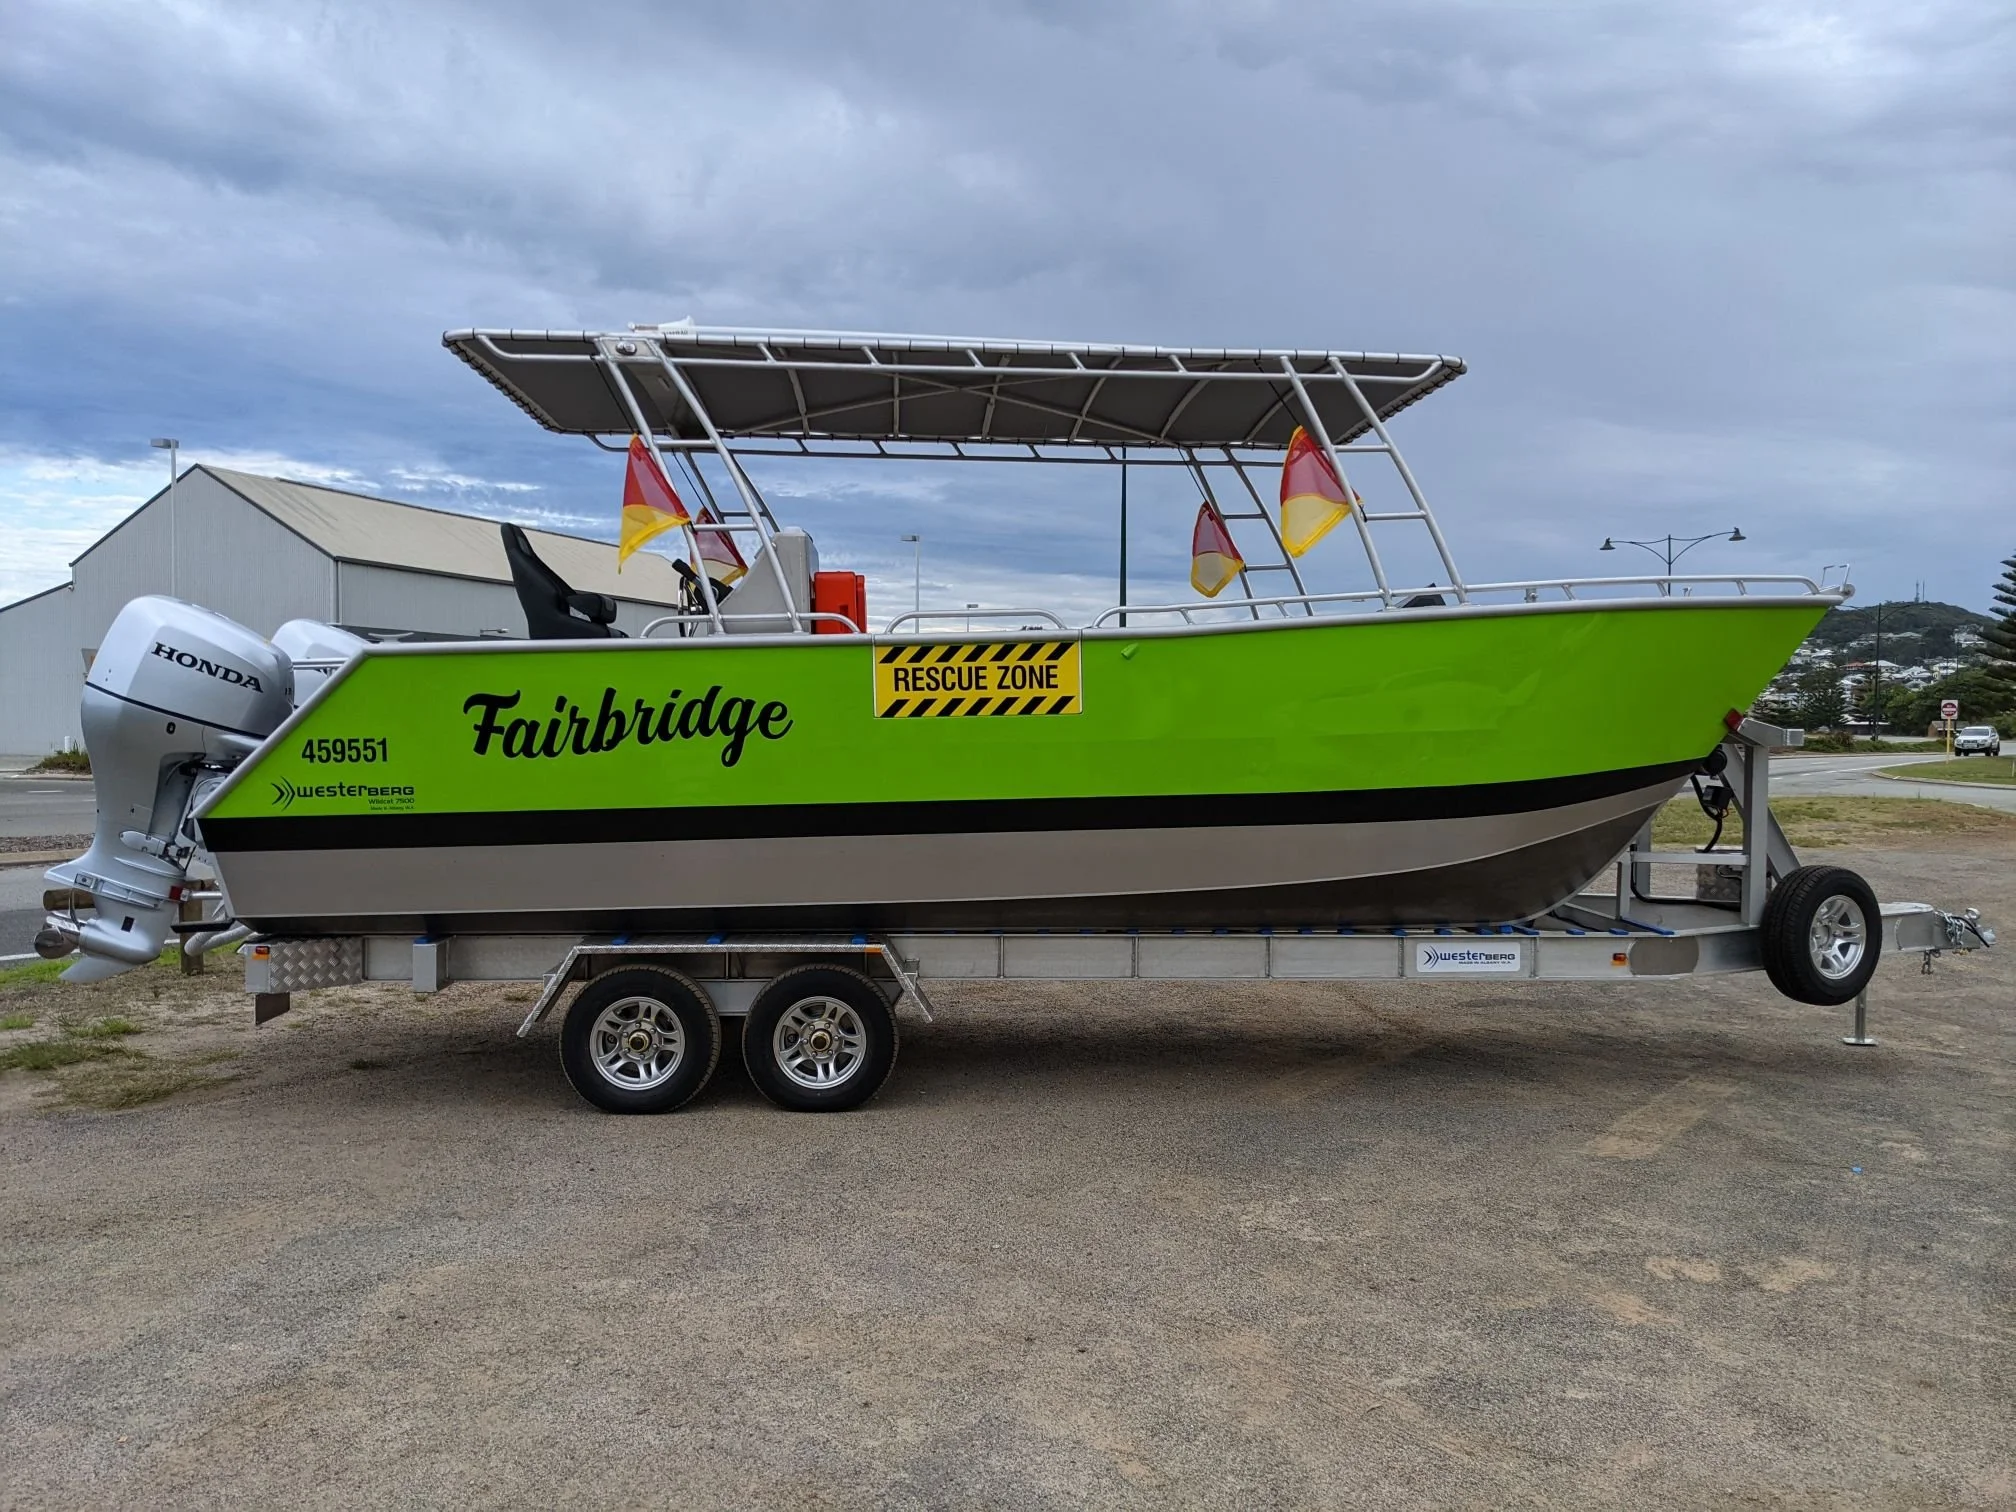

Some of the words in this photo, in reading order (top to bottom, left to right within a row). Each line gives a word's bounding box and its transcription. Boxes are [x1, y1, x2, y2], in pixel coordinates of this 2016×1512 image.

[151, 641, 264, 693] HONDA
[893, 666, 988, 692] RESCUE
[996, 664, 1059, 690] ZONE
[463, 685, 794, 768] Fairbridge
[301, 738, 388, 763] 459551
